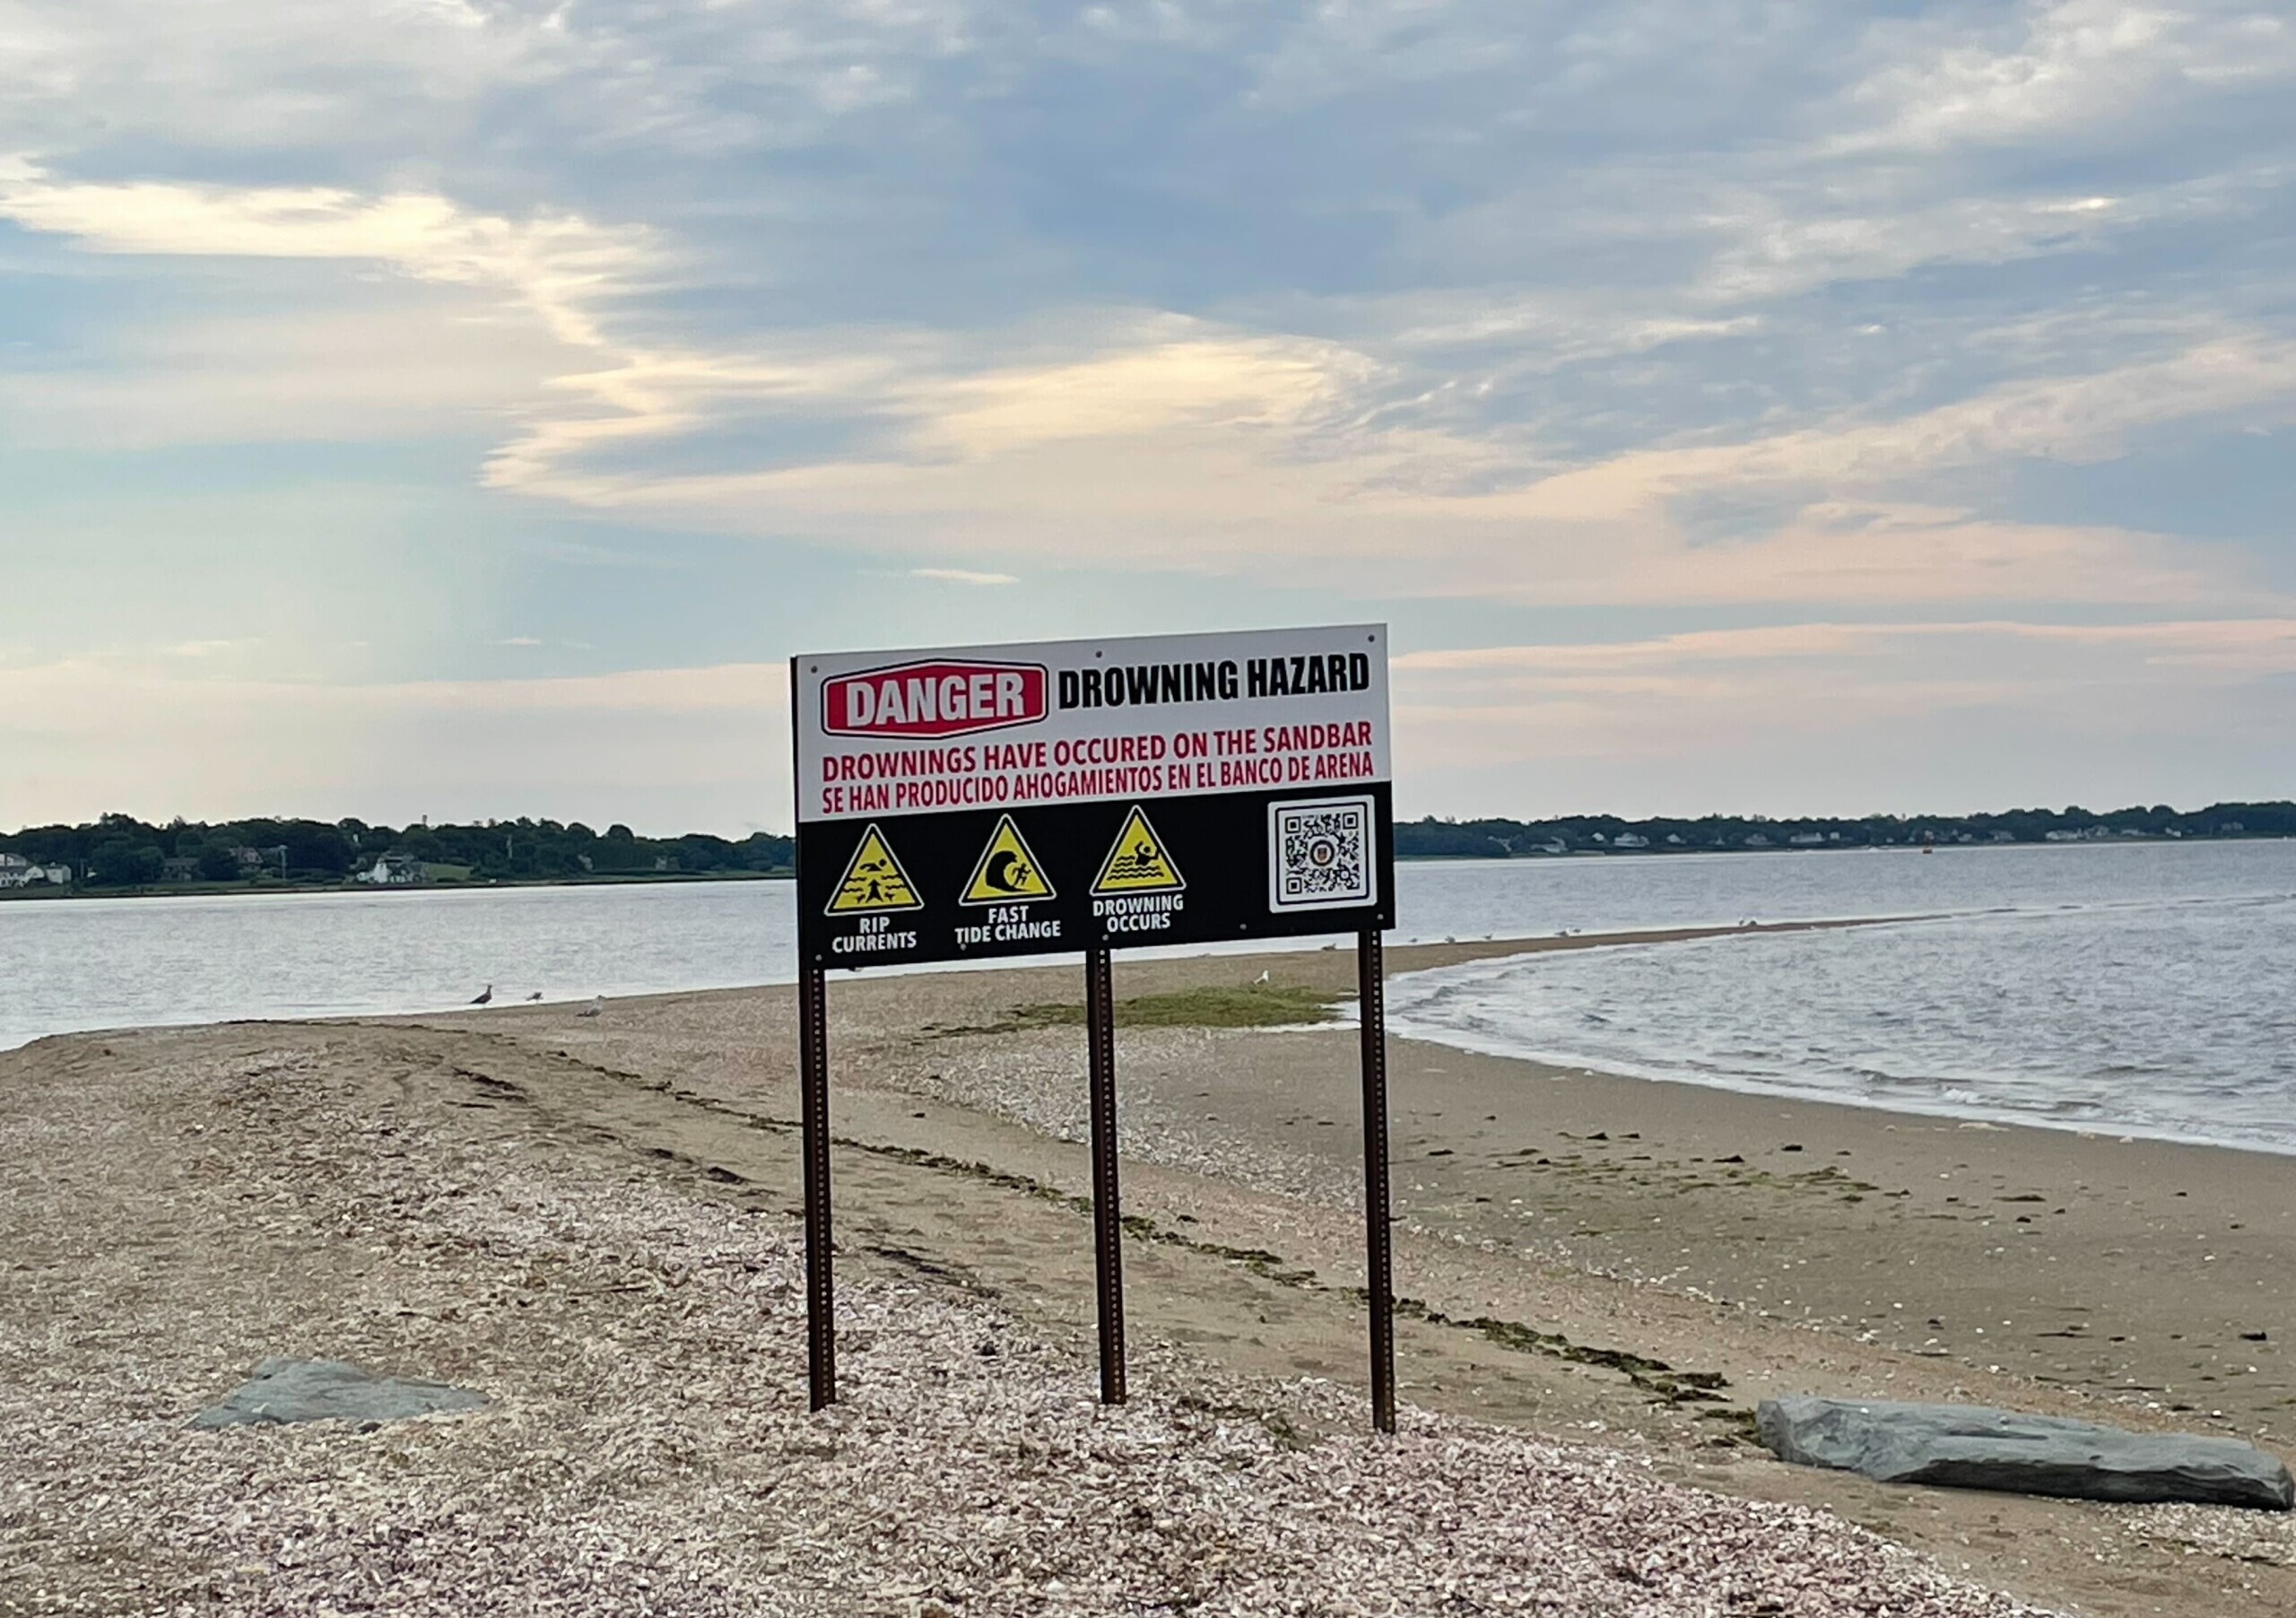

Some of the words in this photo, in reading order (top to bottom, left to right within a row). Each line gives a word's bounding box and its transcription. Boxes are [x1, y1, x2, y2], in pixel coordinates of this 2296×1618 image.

[1058, 660, 1239, 709] DROWNING
[1247, 652, 1370, 698] HAZARD
[847, 672, 1025, 727] DANGER
[822, 746, 976, 782] DROWNINGS
[984, 742, 1047, 770] HAVE
[1054, 735, 1166, 766] OCCURED
[1173, 732, 1207, 759] ON
[1213, 728, 1257, 756] THE
[1263, 720, 1372, 753] SANDBAR
[822, 787, 844, 813] SE
[848, 783, 889, 812] HAN
[896, 775, 1009, 808] PRODUCIDO
[1013, 765, 1162, 800] AHOGAMIENTOS
[1169, 763, 1191, 790] EN
[1196, 761, 1216, 787] EL
[1221, 757, 1282, 787] BANCO
[1288, 755, 1310, 782] DE
[1314, 751, 1374, 779] ARENA
[988, 905, 1029, 924] FAST
[1092, 893, 1184, 917] DROWNING
[859, 917, 891, 934] RIP
[954, 926, 991, 944] TIDE
[995, 920, 1061, 940] CHANGE
[1106, 912, 1170, 933] OCCURS
[832, 931, 917, 953] CURRENTS
